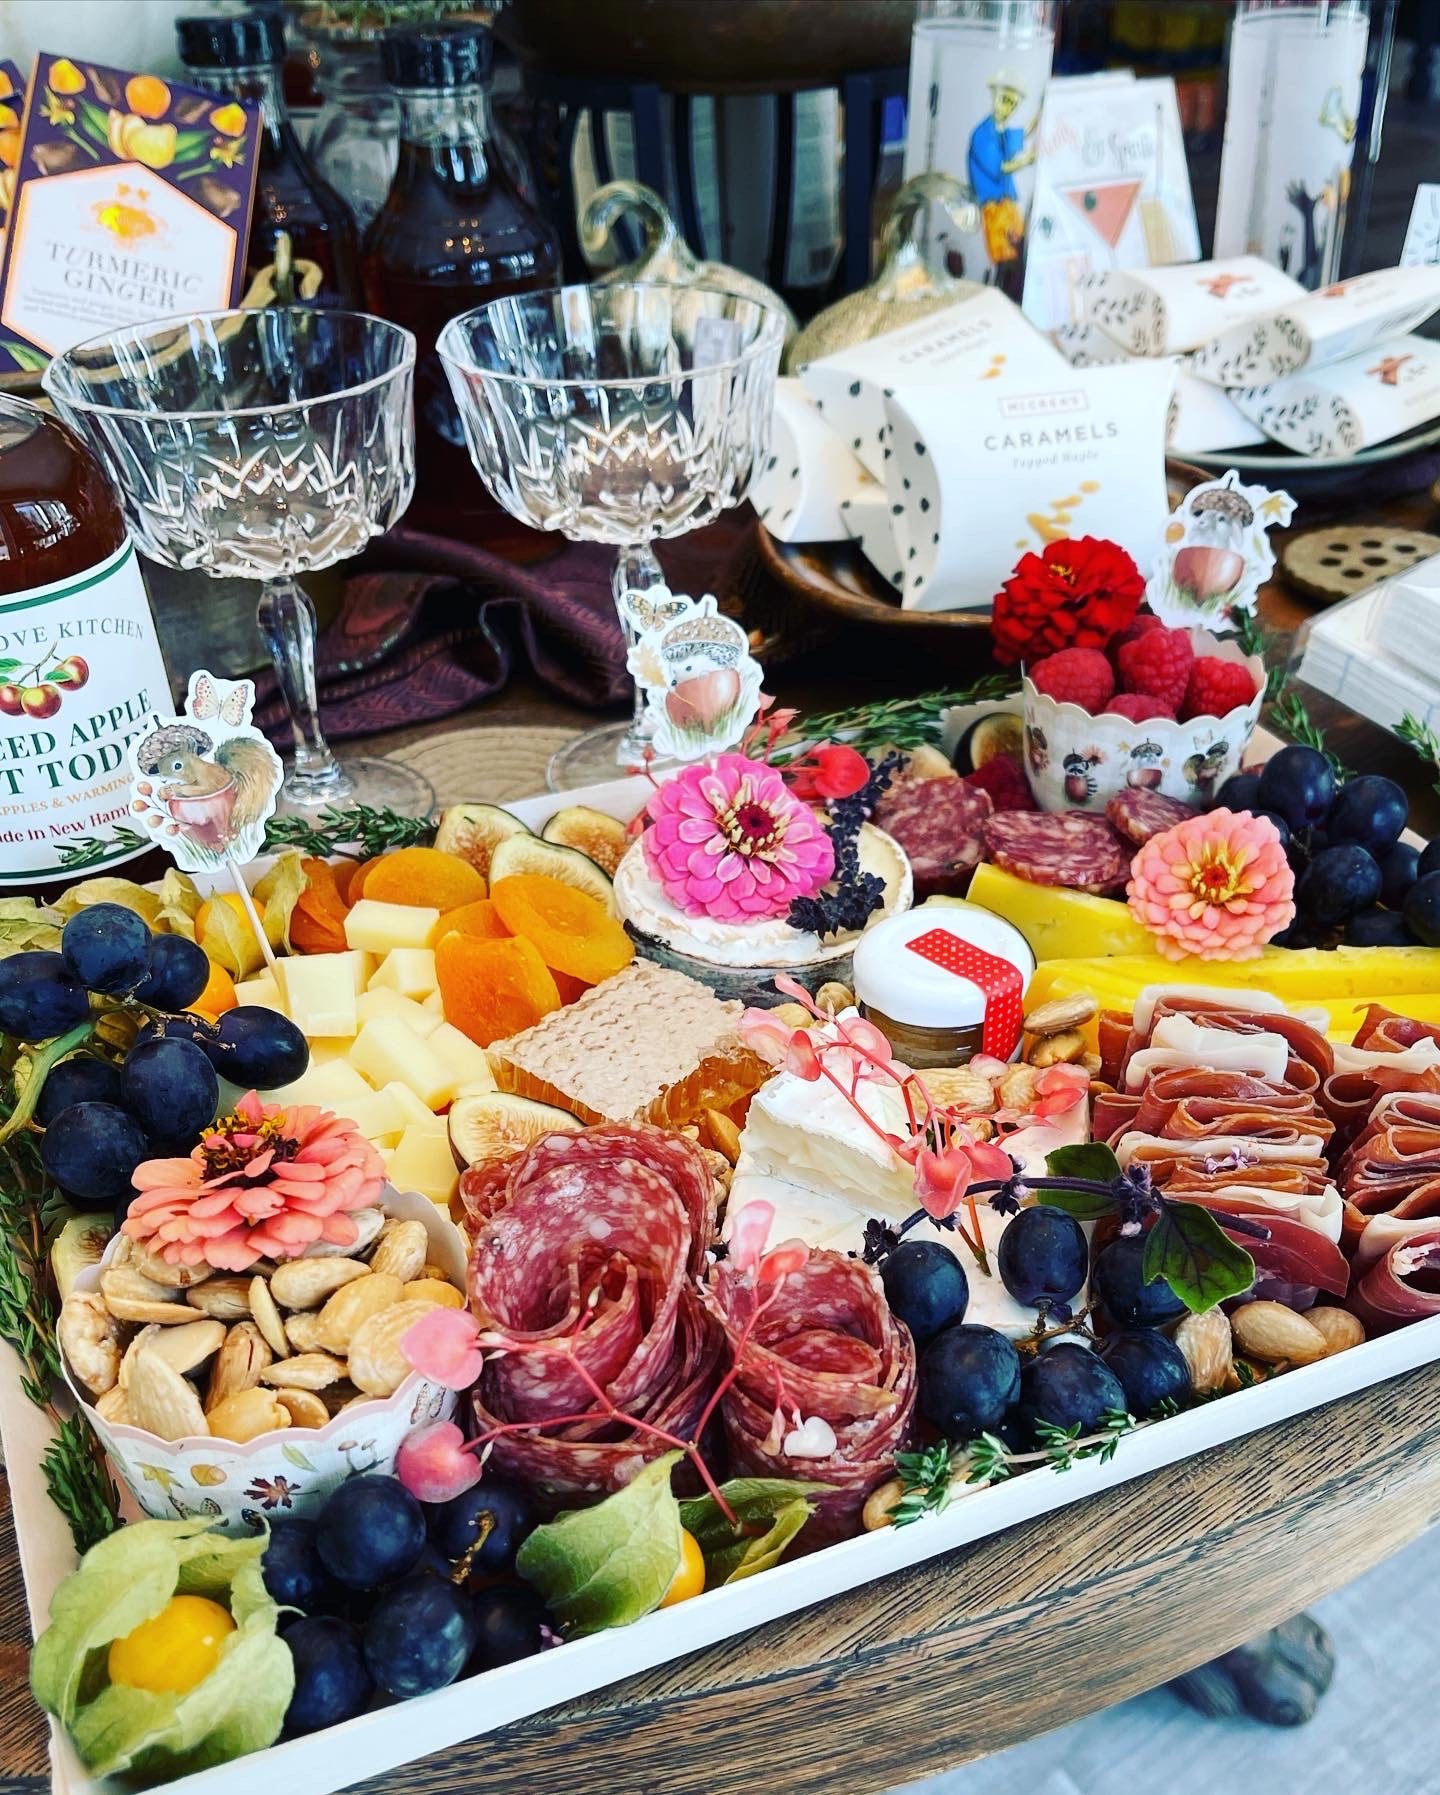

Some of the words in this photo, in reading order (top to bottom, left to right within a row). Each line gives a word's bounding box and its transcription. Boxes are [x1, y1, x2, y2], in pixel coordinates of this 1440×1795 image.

[46, 240, 203, 294] TURMERIC
[64, 268, 176, 312] GINGER
[983, 421, 1118, 451] CARAMELS
[58, 617, 144, 640] KITCHEN
[0, 731, 56, 761] ED
[70, 688, 151, 748] APPLE
[38, 723, 148, 789] TOD
[51, 797, 63, 809] &
[66, 772, 135, 805] WARMING
[49, 818, 86, 838] New
